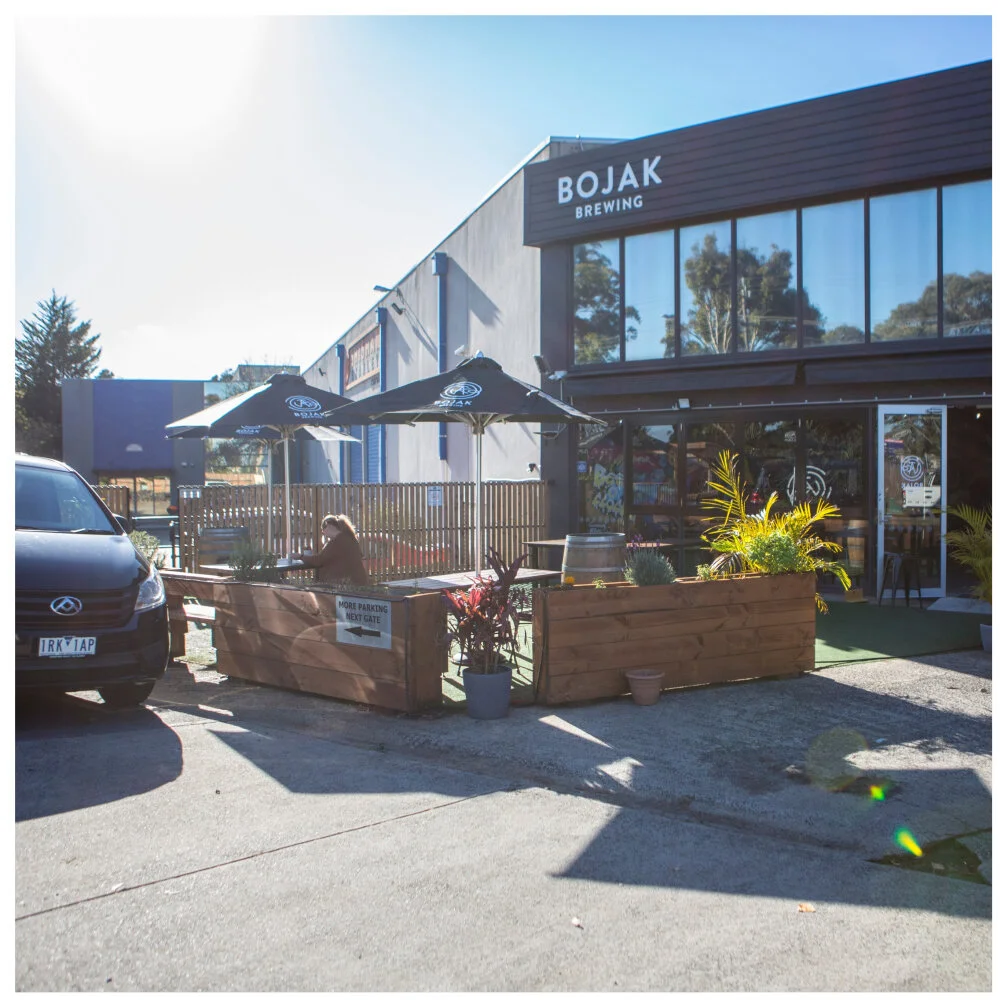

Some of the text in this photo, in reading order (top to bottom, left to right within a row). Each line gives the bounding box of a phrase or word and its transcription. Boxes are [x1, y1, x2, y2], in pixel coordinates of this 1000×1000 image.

[558, 155, 662, 204] BOJAK
[575, 195, 643, 219] BREWING
[338, 601, 389, 614] MORE PARKING
[346, 612, 381, 624] NEXT GATE
